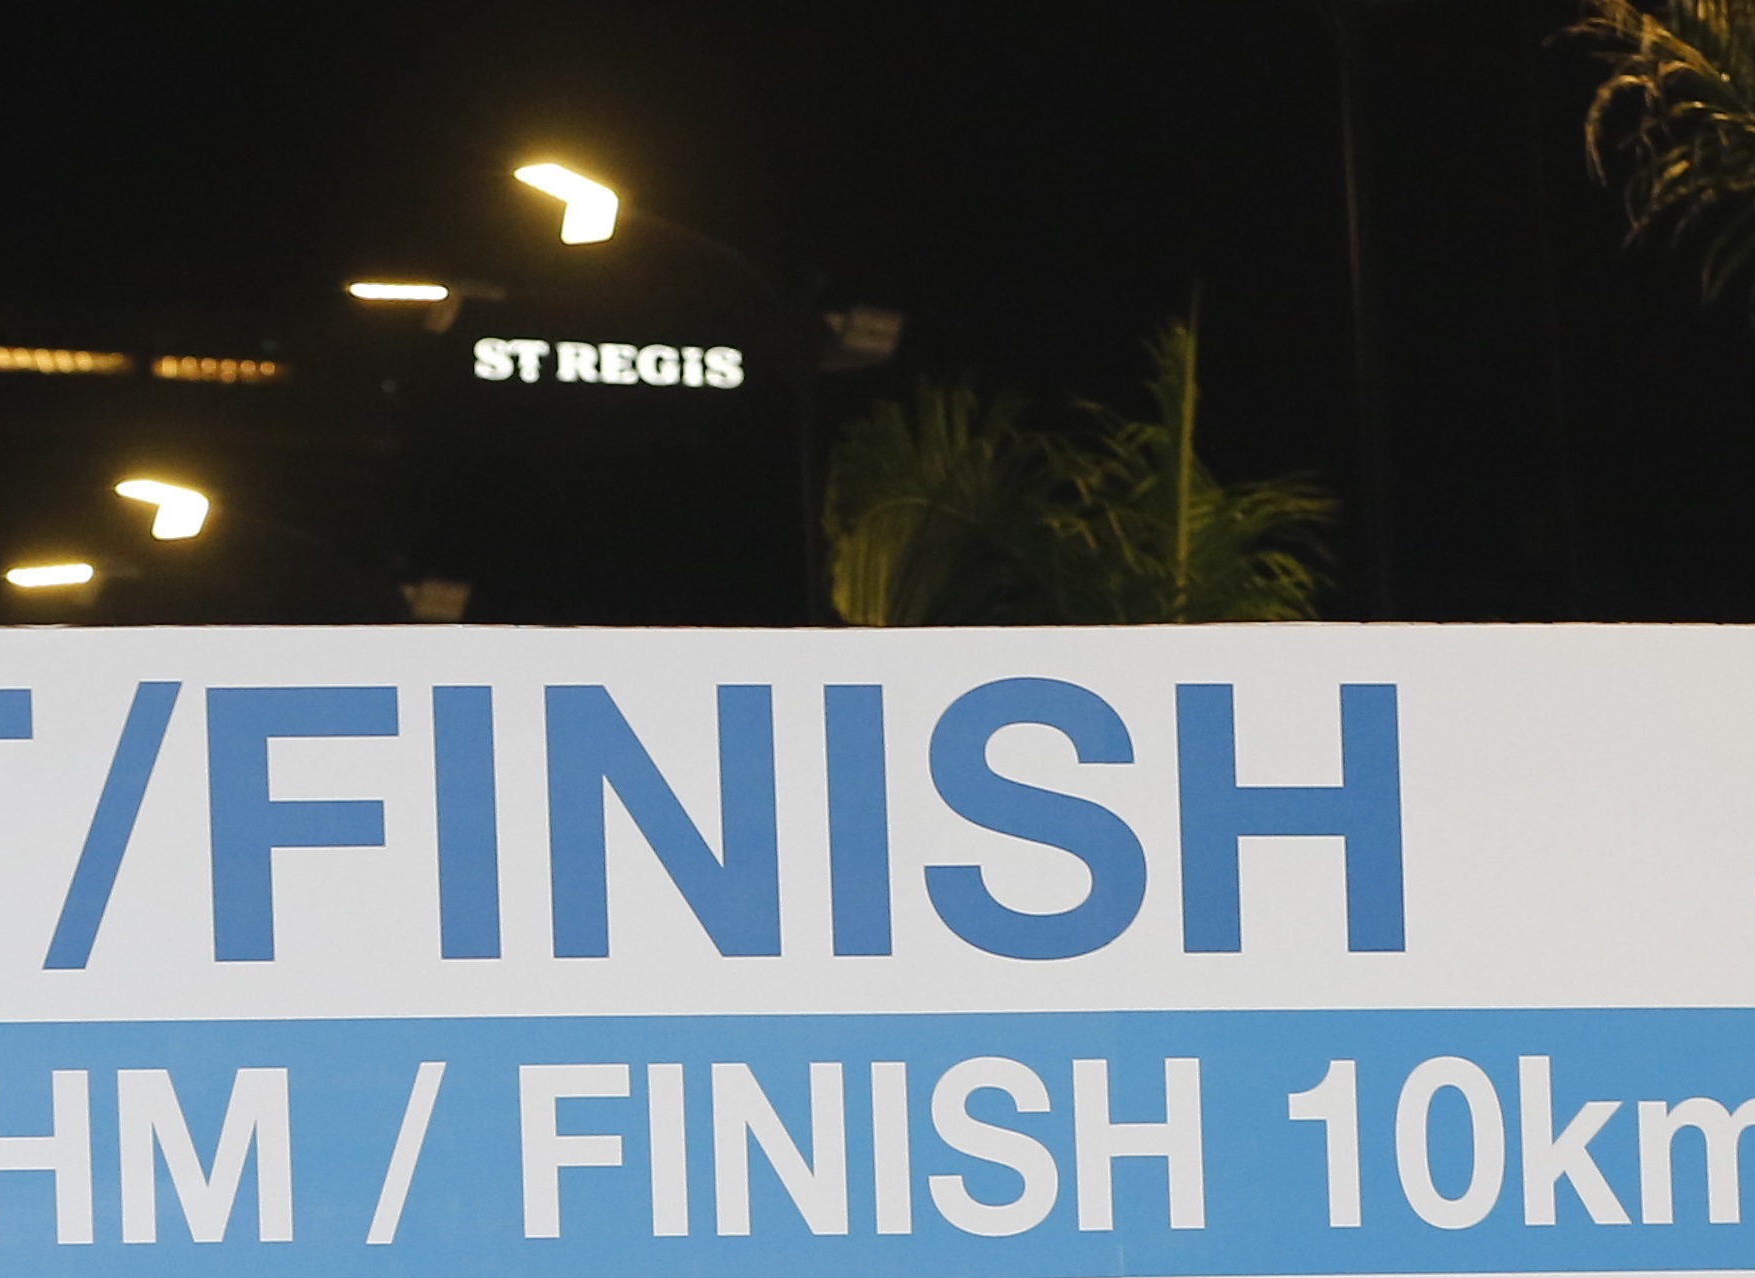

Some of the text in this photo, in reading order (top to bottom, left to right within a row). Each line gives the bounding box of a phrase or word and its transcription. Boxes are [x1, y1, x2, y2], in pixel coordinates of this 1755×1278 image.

[473, 337, 745, 390] ST REGIS
[517, 1058, 1203, 1241] FINISH
